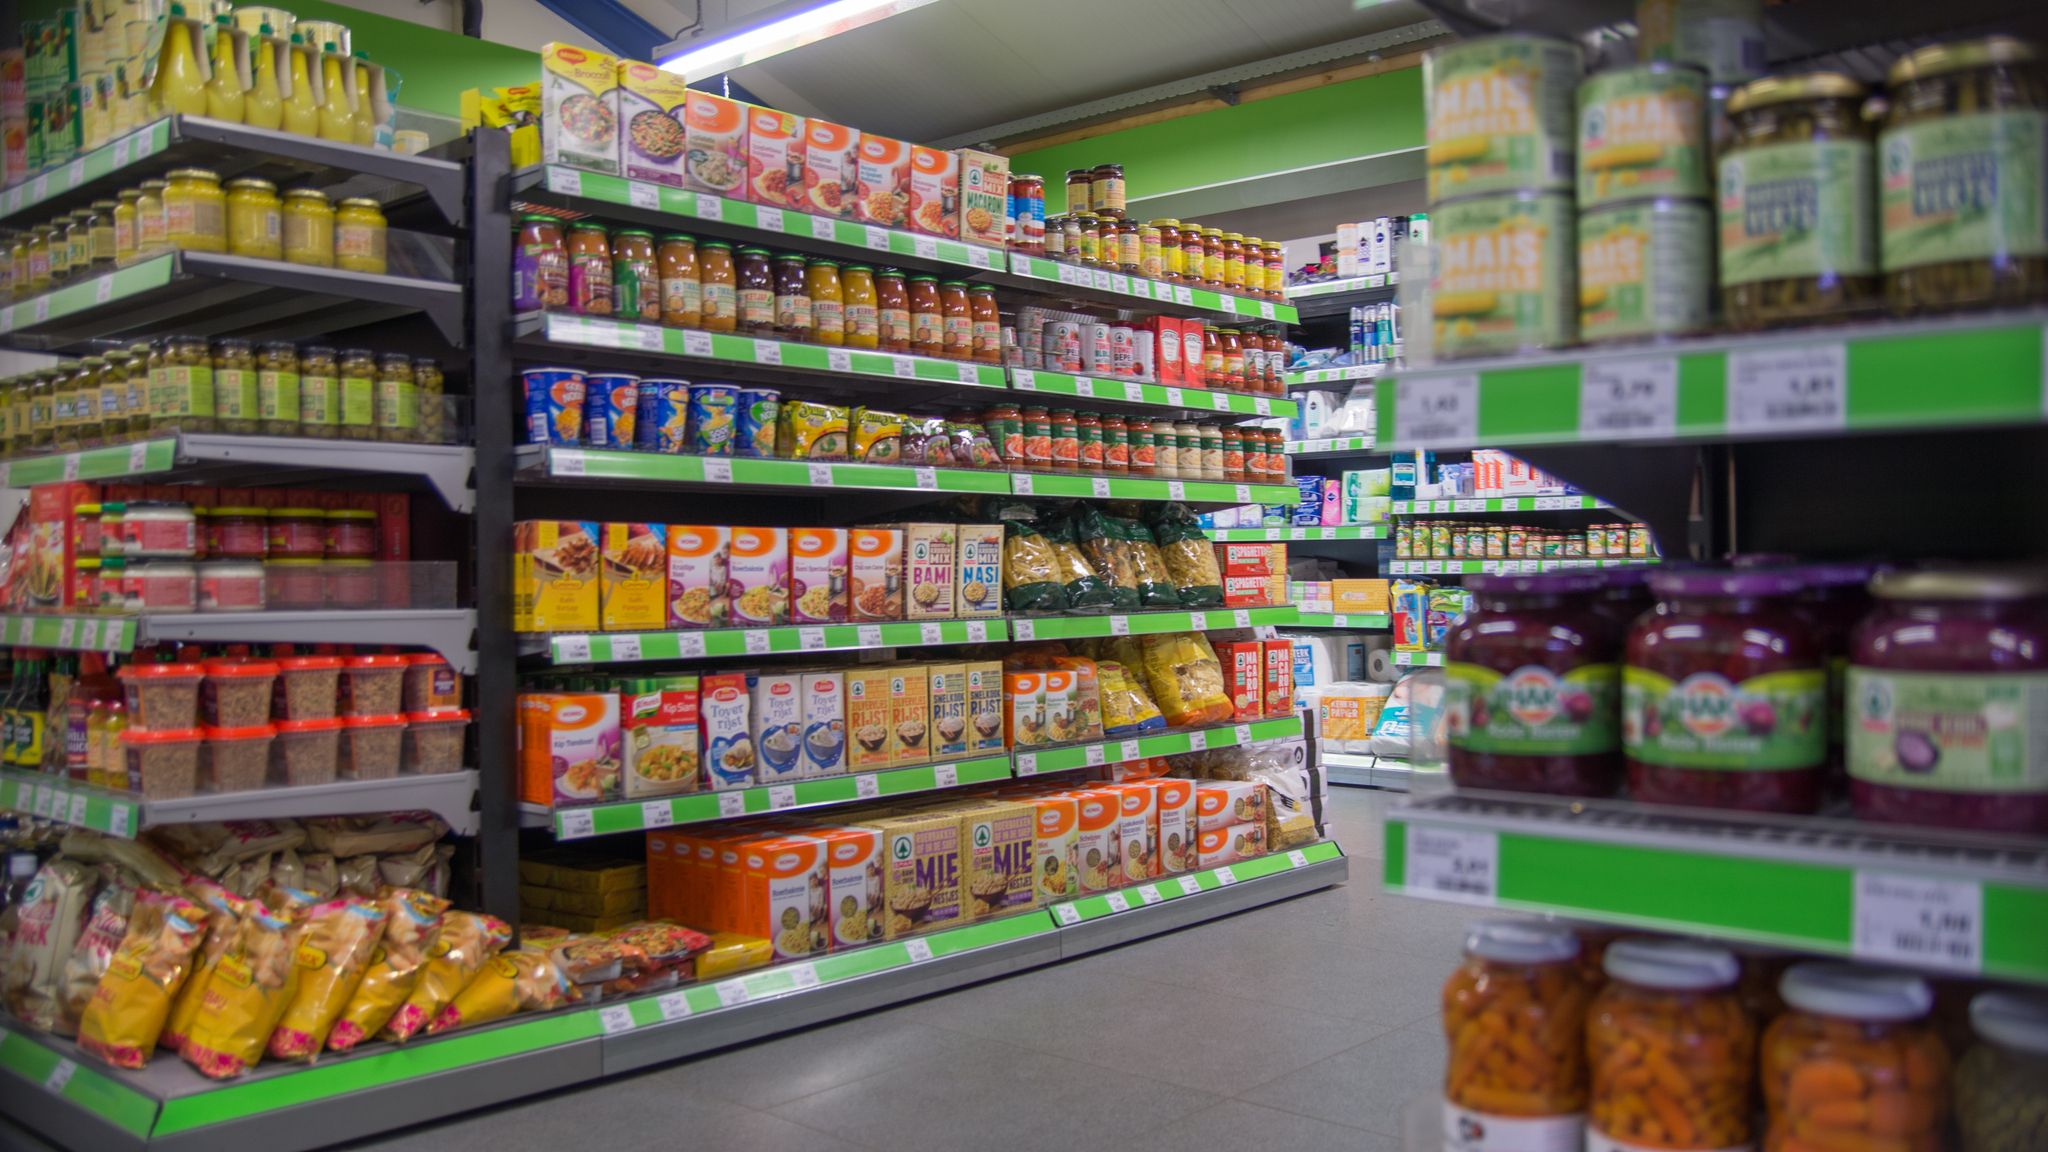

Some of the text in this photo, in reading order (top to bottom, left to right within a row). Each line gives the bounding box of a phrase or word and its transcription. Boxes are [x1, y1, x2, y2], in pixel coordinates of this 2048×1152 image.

[1448, 230, 1539, 268] MAIS
[930, 553, 951, 563] MIX
[978, 553, 998, 563] MIX
[913, 566, 951, 584] BAMI
[963, 566, 998, 584] NASI
[1246, 677, 1257, 690] RO
[812, 694, 837, 705] Tover
[970, 699, 1001, 717] RIJST
[710, 704, 744, 718] Tover
[851, 710, 888, 729] RIJST
[893, 707, 926, 724] RIJST
[933, 703, 965, 720] RIJST
[717, 716, 743, 731] rijst
[993, 840, 1032, 877] MIE
[916, 852, 958, 890] MIE
